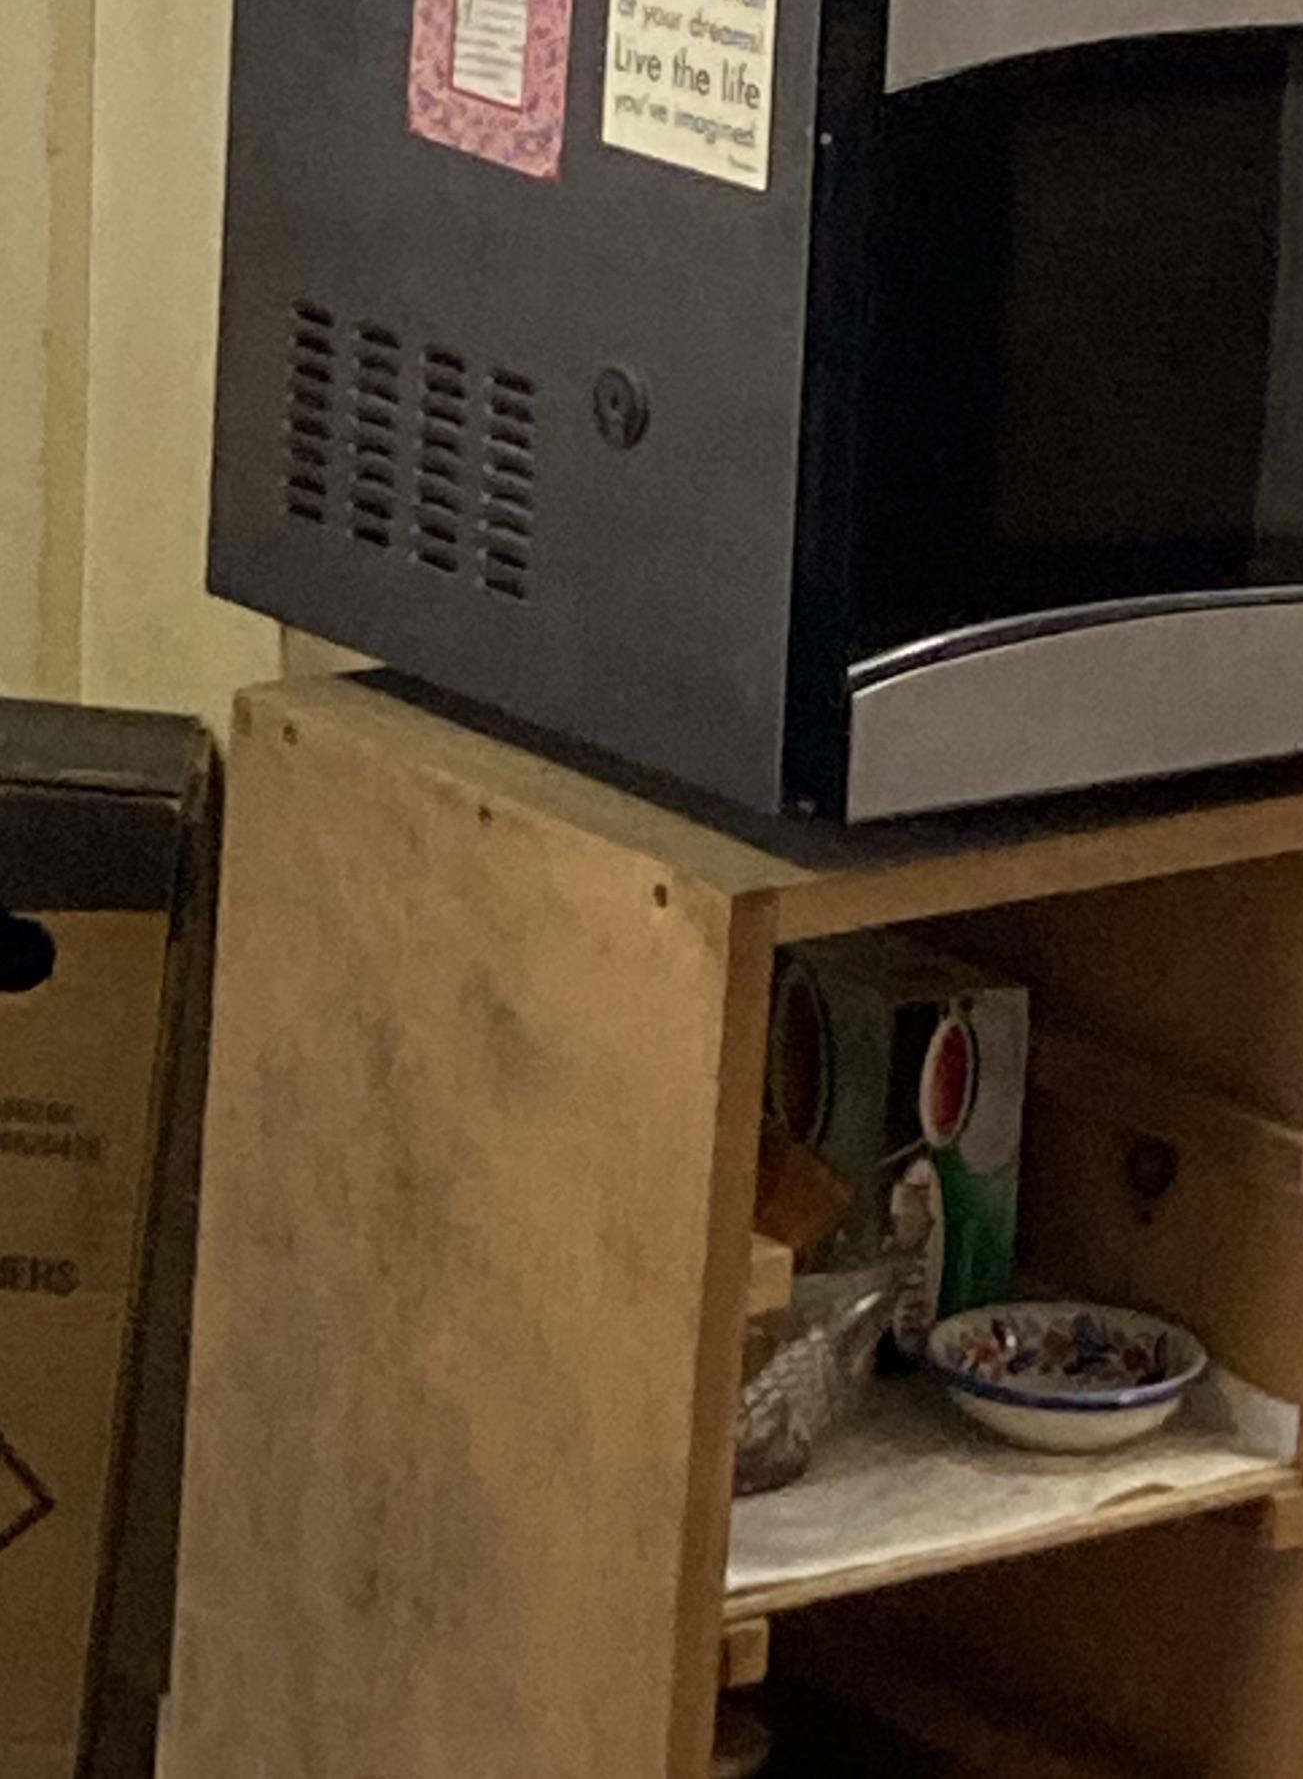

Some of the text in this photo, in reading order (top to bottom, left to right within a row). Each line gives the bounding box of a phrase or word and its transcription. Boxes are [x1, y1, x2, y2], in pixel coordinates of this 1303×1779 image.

[642, 5, 683, 30] your
[614, 31, 761, 110] Live the life
